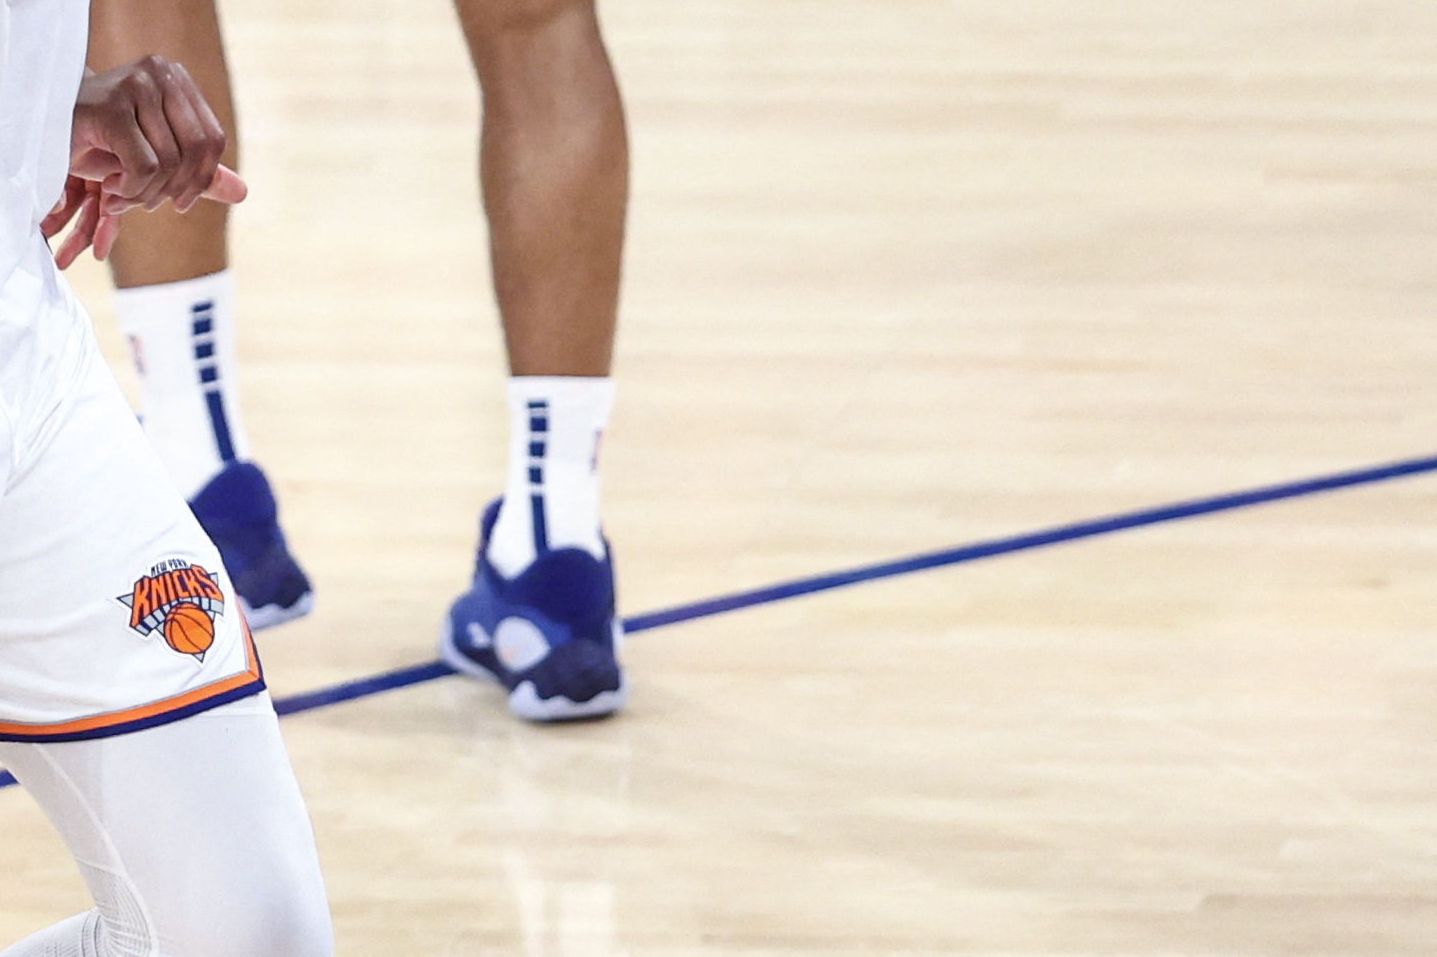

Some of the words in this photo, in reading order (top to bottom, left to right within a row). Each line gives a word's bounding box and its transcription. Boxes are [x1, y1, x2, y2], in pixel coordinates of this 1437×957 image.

[150, 560, 167, 578] NEW
[167, 558, 189, 570] YORK
[130, 564, 224, 628] KNICKS
